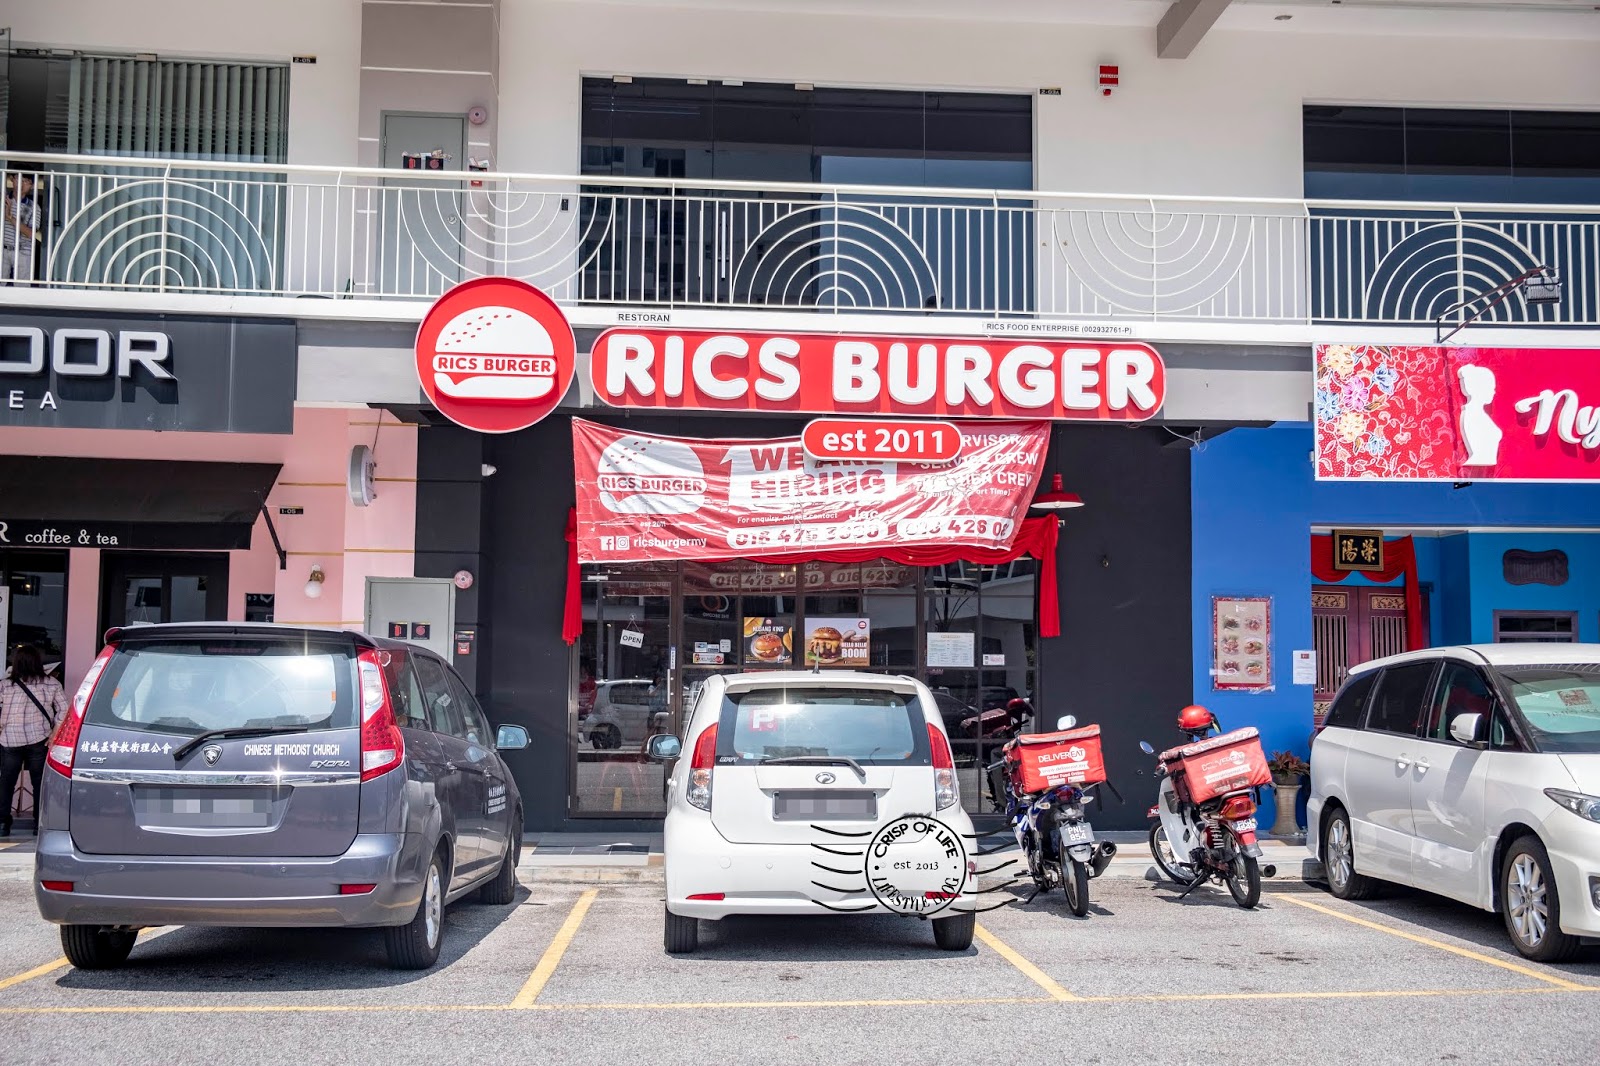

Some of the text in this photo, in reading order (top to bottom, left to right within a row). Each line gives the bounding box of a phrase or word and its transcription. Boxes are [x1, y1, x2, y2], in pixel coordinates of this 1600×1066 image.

[618, 313, 670, 322] RESTORAN
[986, 323, 1005, 331] RICS
[1031, 324, 1080, 333] ENTERPRISE
[438, 357, 551, 372] RICS BURGER
[606, 334, 1157, 411] RICS BURGER
[822, 429, 944, 453] est 2011
[750, 447, 804, 471] WE
[601, 477, 702, 491] RICS BURGER
[751, 469, 886, 498] HIRING
[737, 516, 750, 524] For
[948, 519, 987, 534] 426
[25, 528, 119, 545] coffee & tea
[633, 536, 707, 548] ricsburgermy
[622, 635, 642, 645] OPEN
[841, 649, 867, 658] BOOM
[753, 710, 774, 729] P
[244, 744, 340, 756] CHINESE METHODIST CHURCH
[1068, 826, 1085, 835] PNL
[1070, 833, 1087, 841] 854
